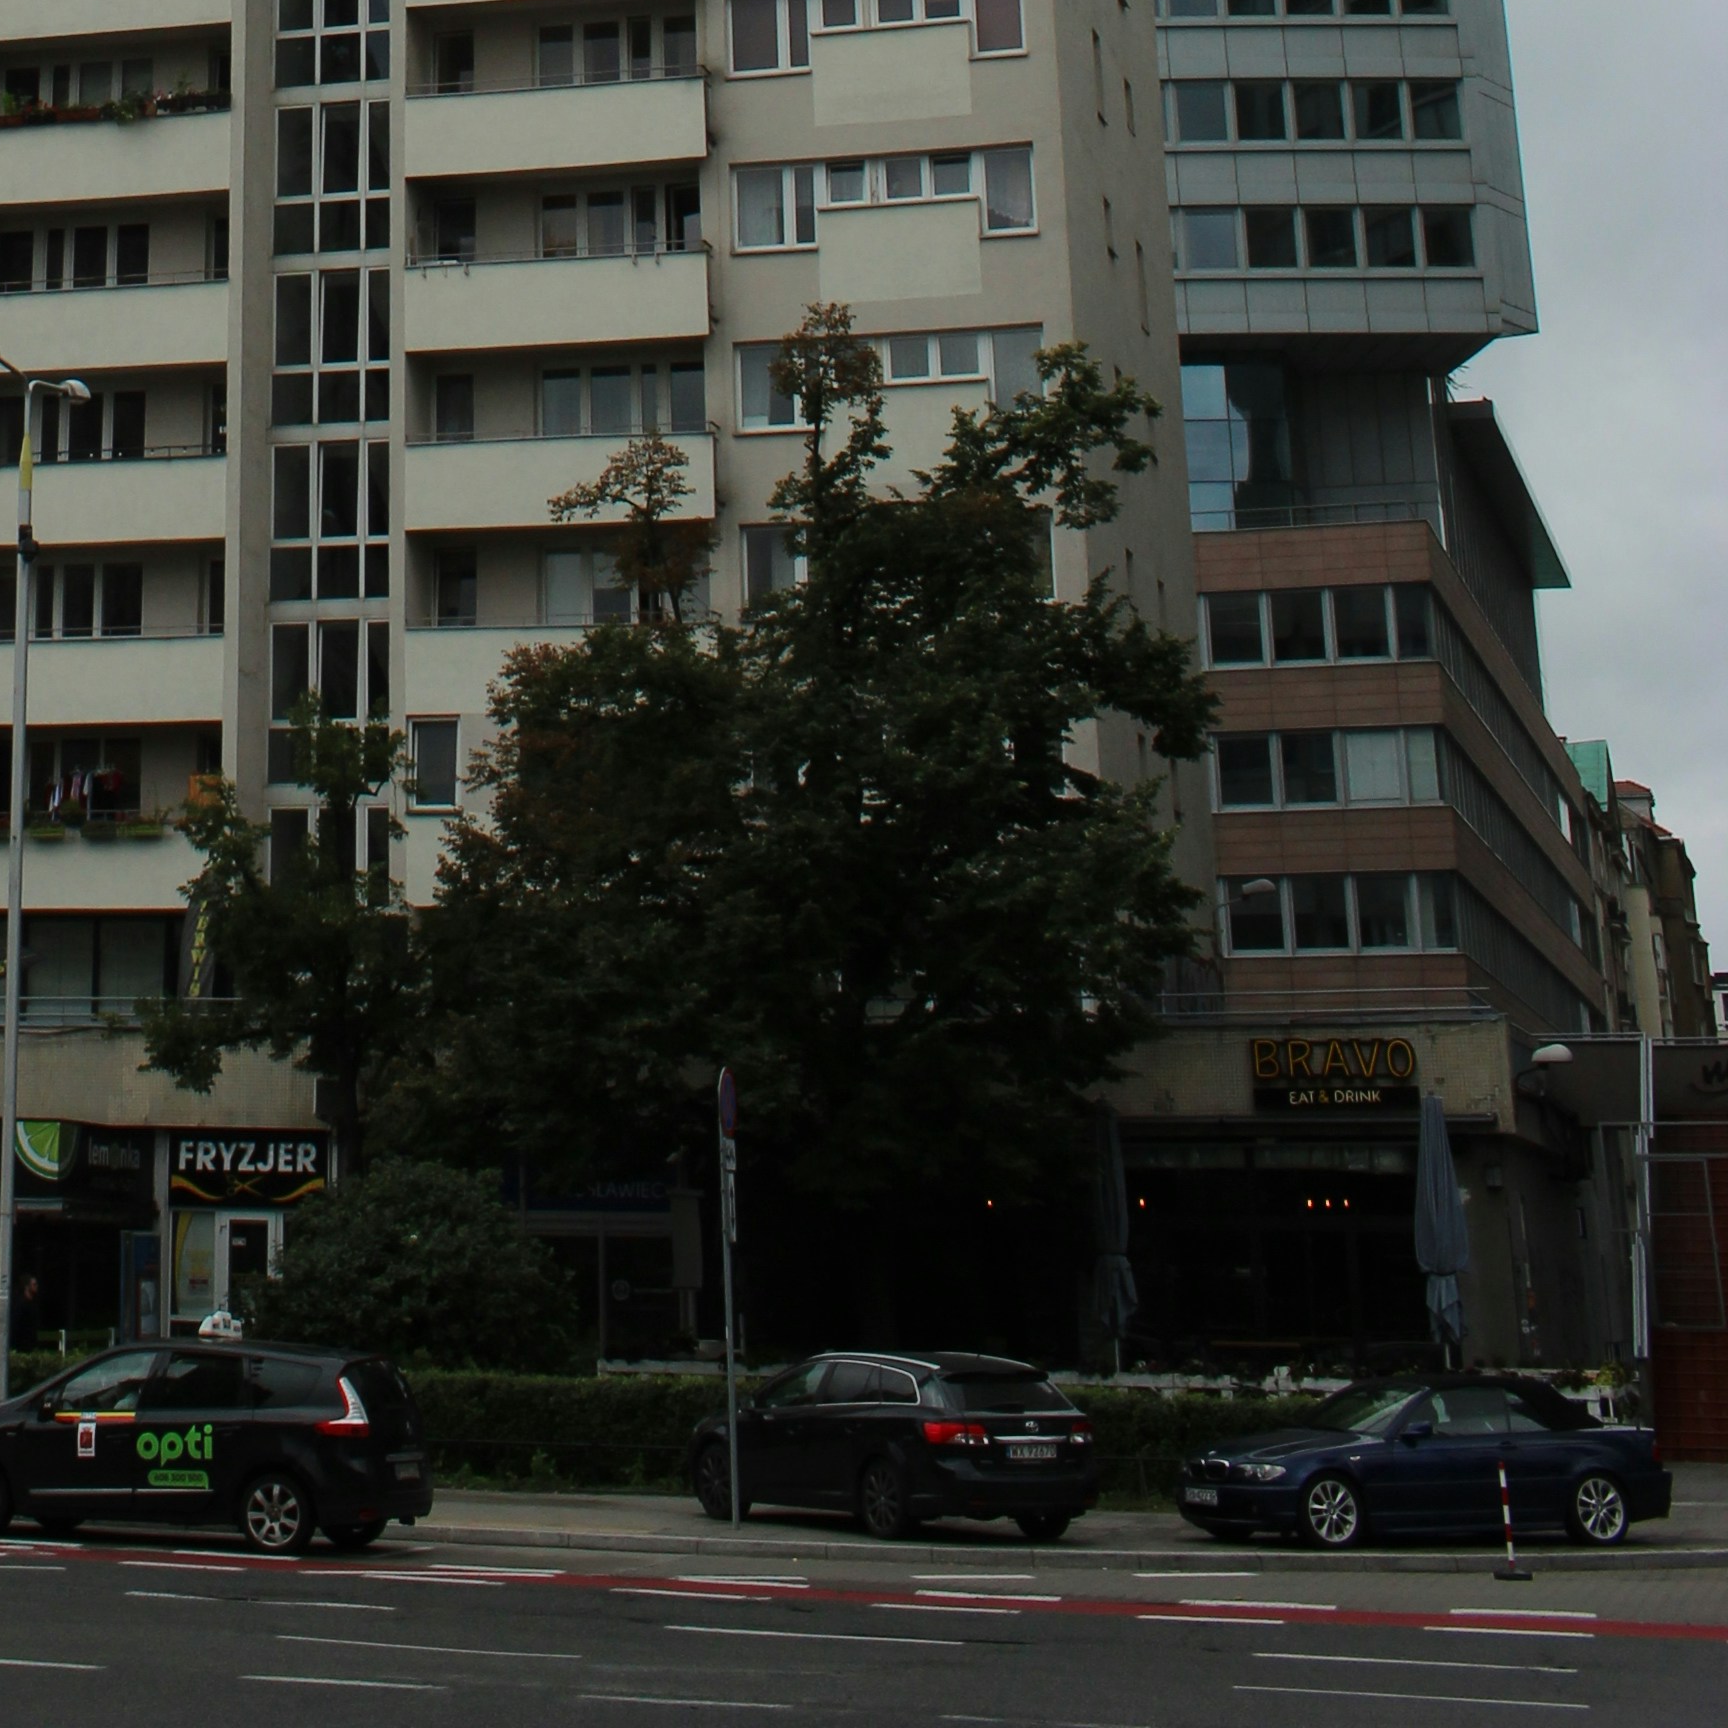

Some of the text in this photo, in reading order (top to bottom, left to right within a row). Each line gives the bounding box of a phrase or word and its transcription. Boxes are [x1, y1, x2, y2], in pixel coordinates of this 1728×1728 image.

[1251, 1037, 1416, 1080] BRAVO
[1288, 1089, 1382, 1105] EAT & DRINK
[177, 1139, 317, 1174] FRYZJER
[136, 1424, 213, 1467] opti
